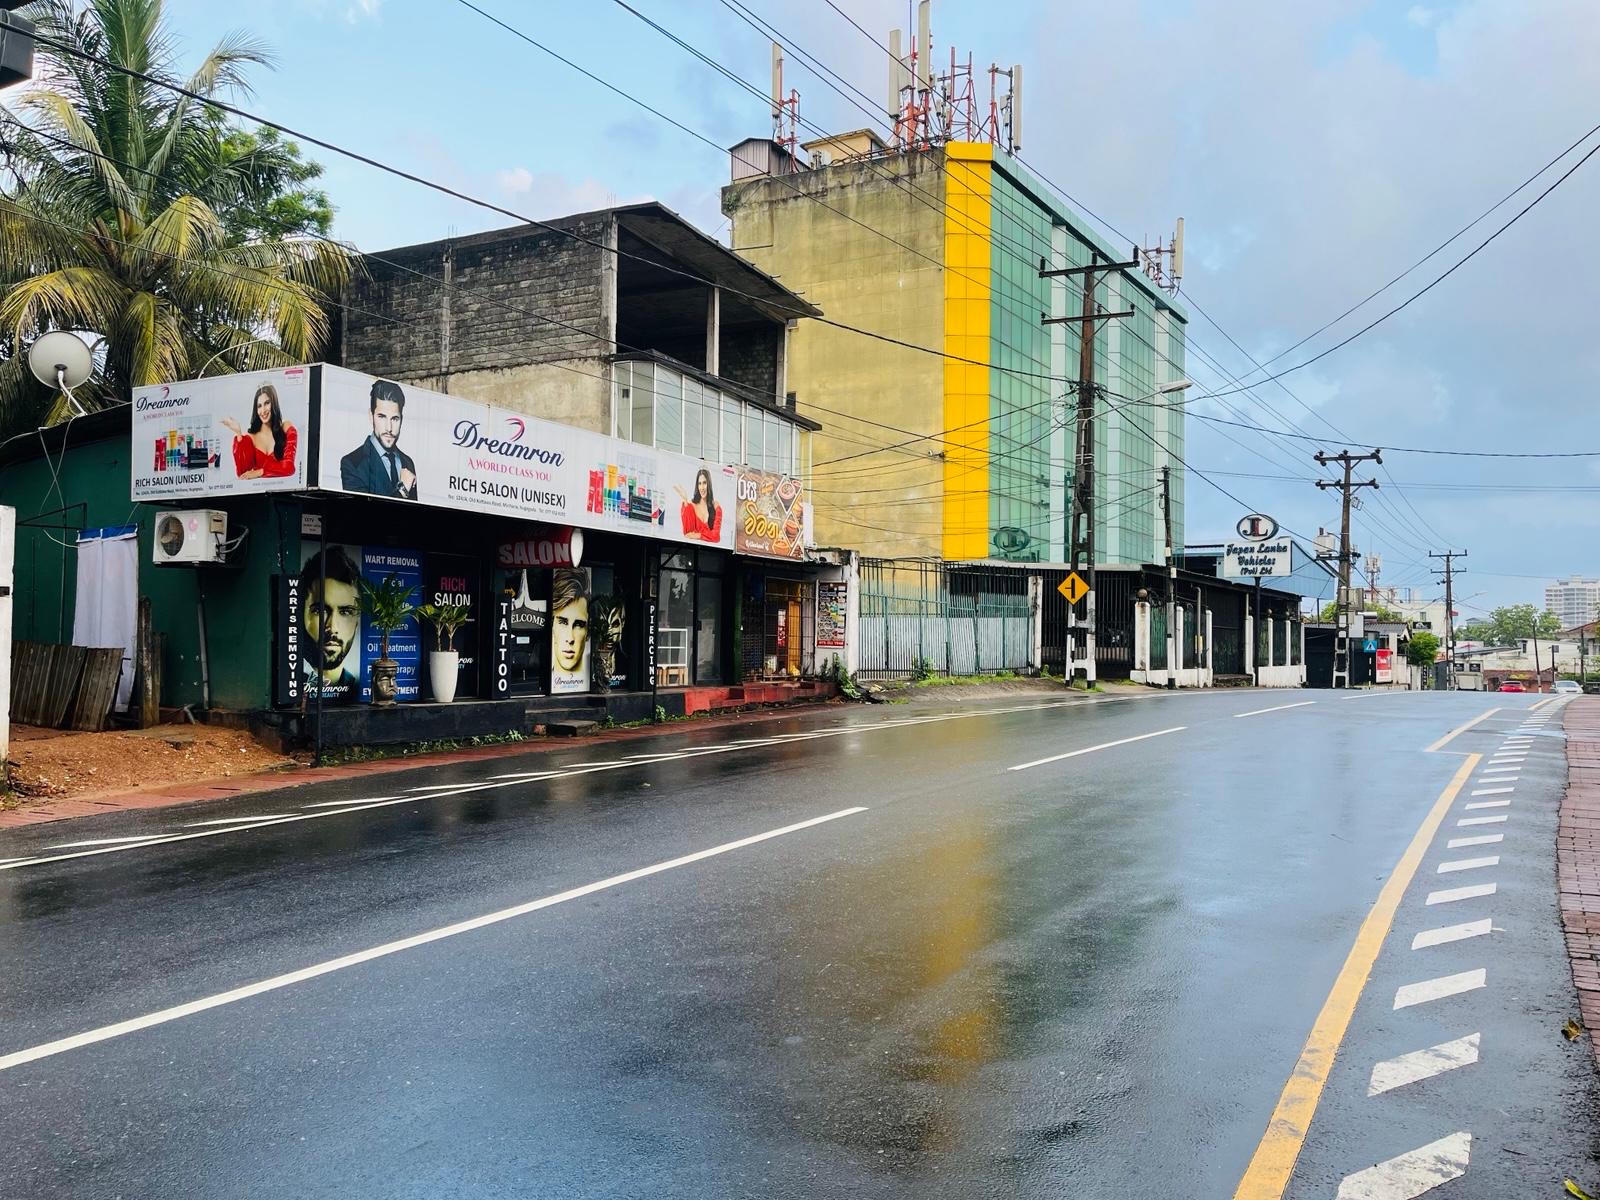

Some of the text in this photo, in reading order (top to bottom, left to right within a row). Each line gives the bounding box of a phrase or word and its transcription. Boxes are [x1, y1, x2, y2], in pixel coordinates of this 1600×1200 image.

[136, 395, 190, 412] Dreamron
[452, 420, 565, 467] Dreamron
[467, 457, 552, 481] A WORLD CLASS YOU
[135, 473, 205, 488] RICH SALON (UNISEX)
[449, 475, 566, 509] RICH SALON (UNISEX)
[1241, 517, 1269, 537] JL
[498, 540, 570, 565] SALON
[1226, 542, 1288, 556] Japan Lanka
[364, 554, 419, 567] WART REMOVAL
[1238, 555, 1276, 566] Vehicles
[1259, 566, 1273, 575] Ltd
[440, 576, 466, 592] RICH
[434, 592, 471, 607] SALON
[511, 613, 545, 627] ELCOME
[288, 579, 299, 697] WARTS REMOVING
[648, 605, 656, 686] PIERCING
[367, 642, 378, 652] Oil
[498, 602, 509, 691] TATTOO
